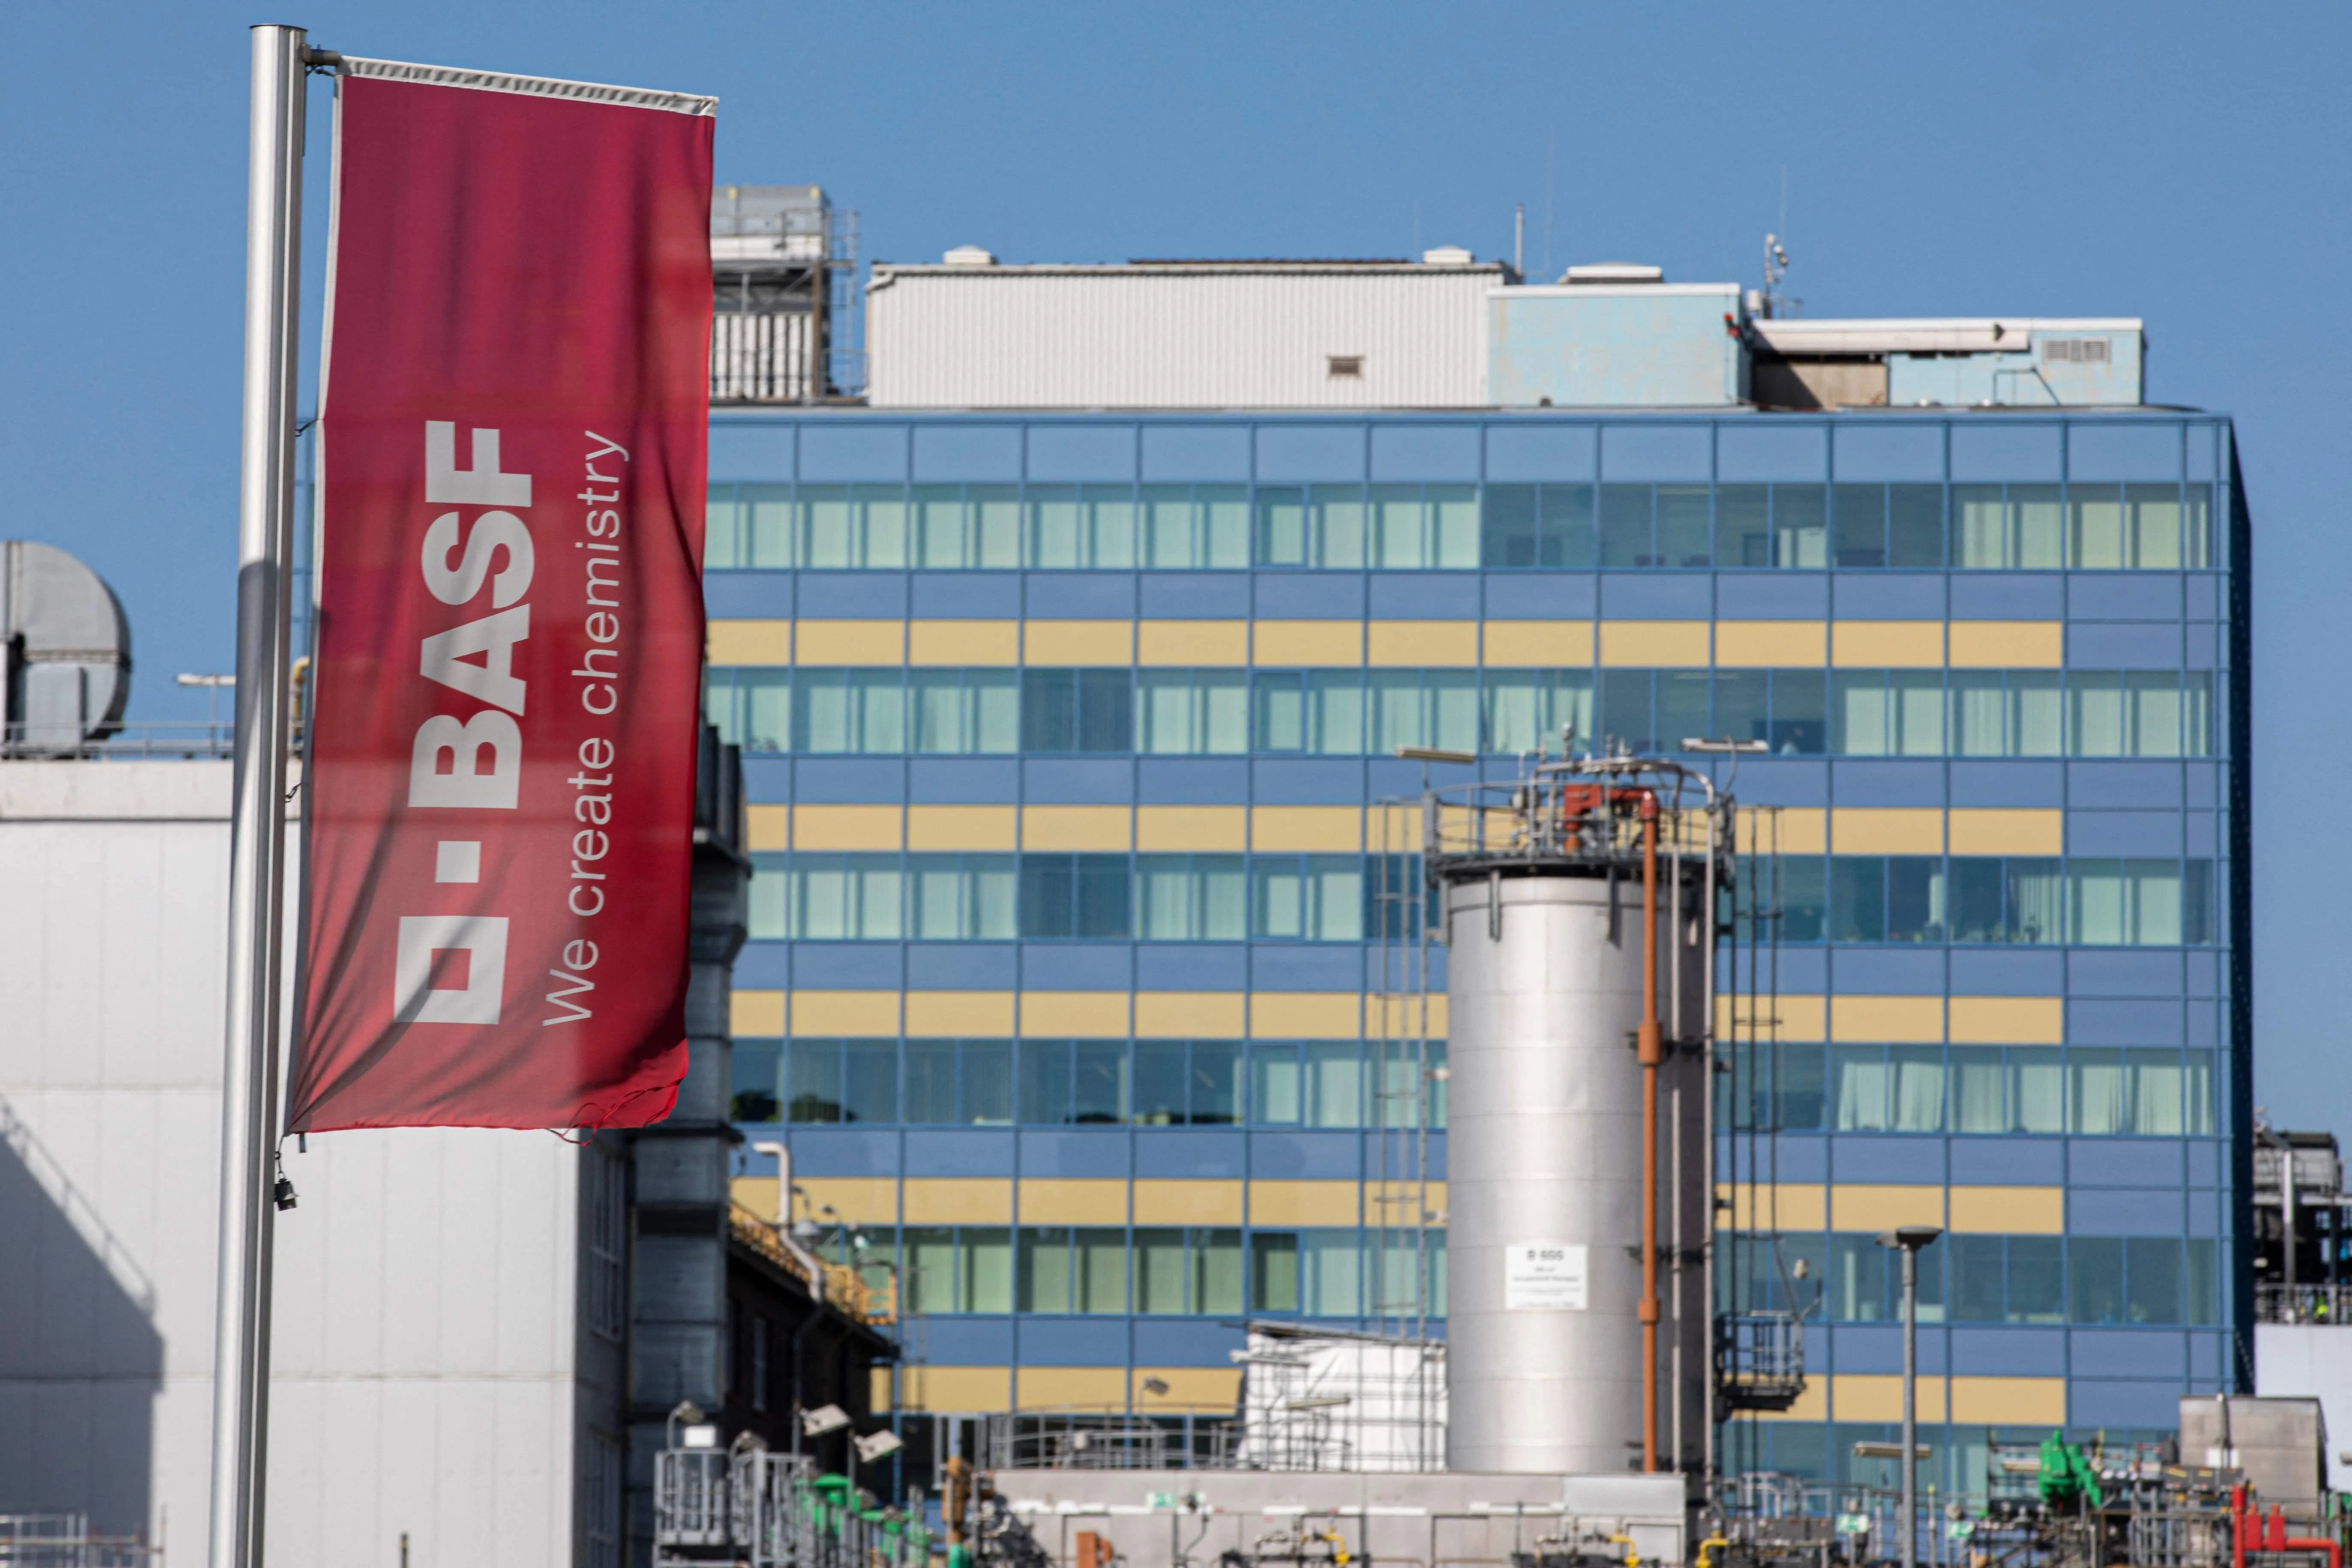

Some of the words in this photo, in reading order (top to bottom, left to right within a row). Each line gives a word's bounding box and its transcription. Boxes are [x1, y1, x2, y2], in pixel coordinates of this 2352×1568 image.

[406, 420, 535, 810] BASF
[571, 430, 629, 715] chemistry
[566, 737, 614, 917] create
[541, 939, 599, 1027] We
